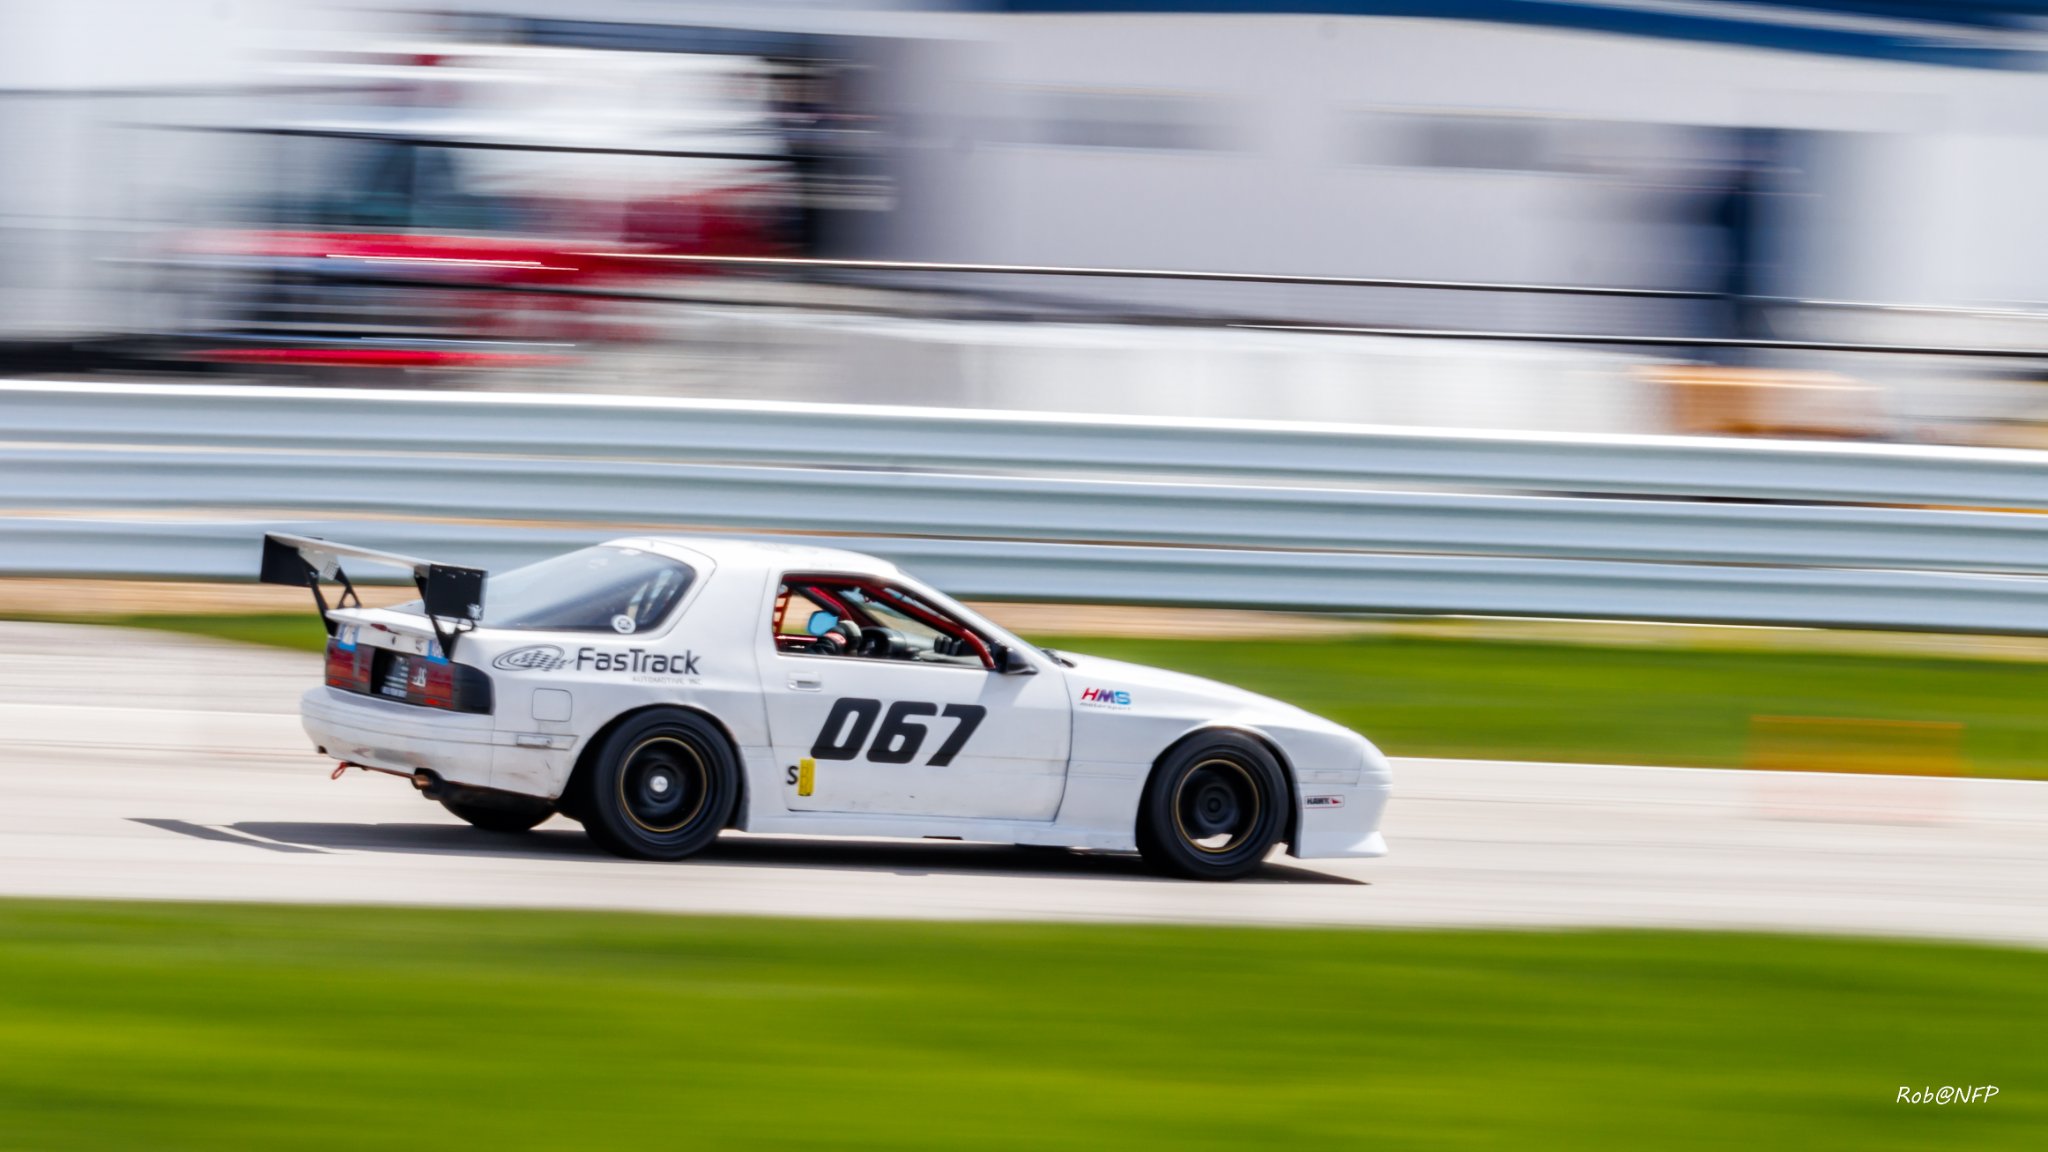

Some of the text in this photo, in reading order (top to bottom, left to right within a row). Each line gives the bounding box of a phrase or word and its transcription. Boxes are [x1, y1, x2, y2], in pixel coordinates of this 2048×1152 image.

[576, 647, 700, 675] FasTrack
[1081, 687, 1131, 705] HMS
[811, 697, 987, 767] 067
